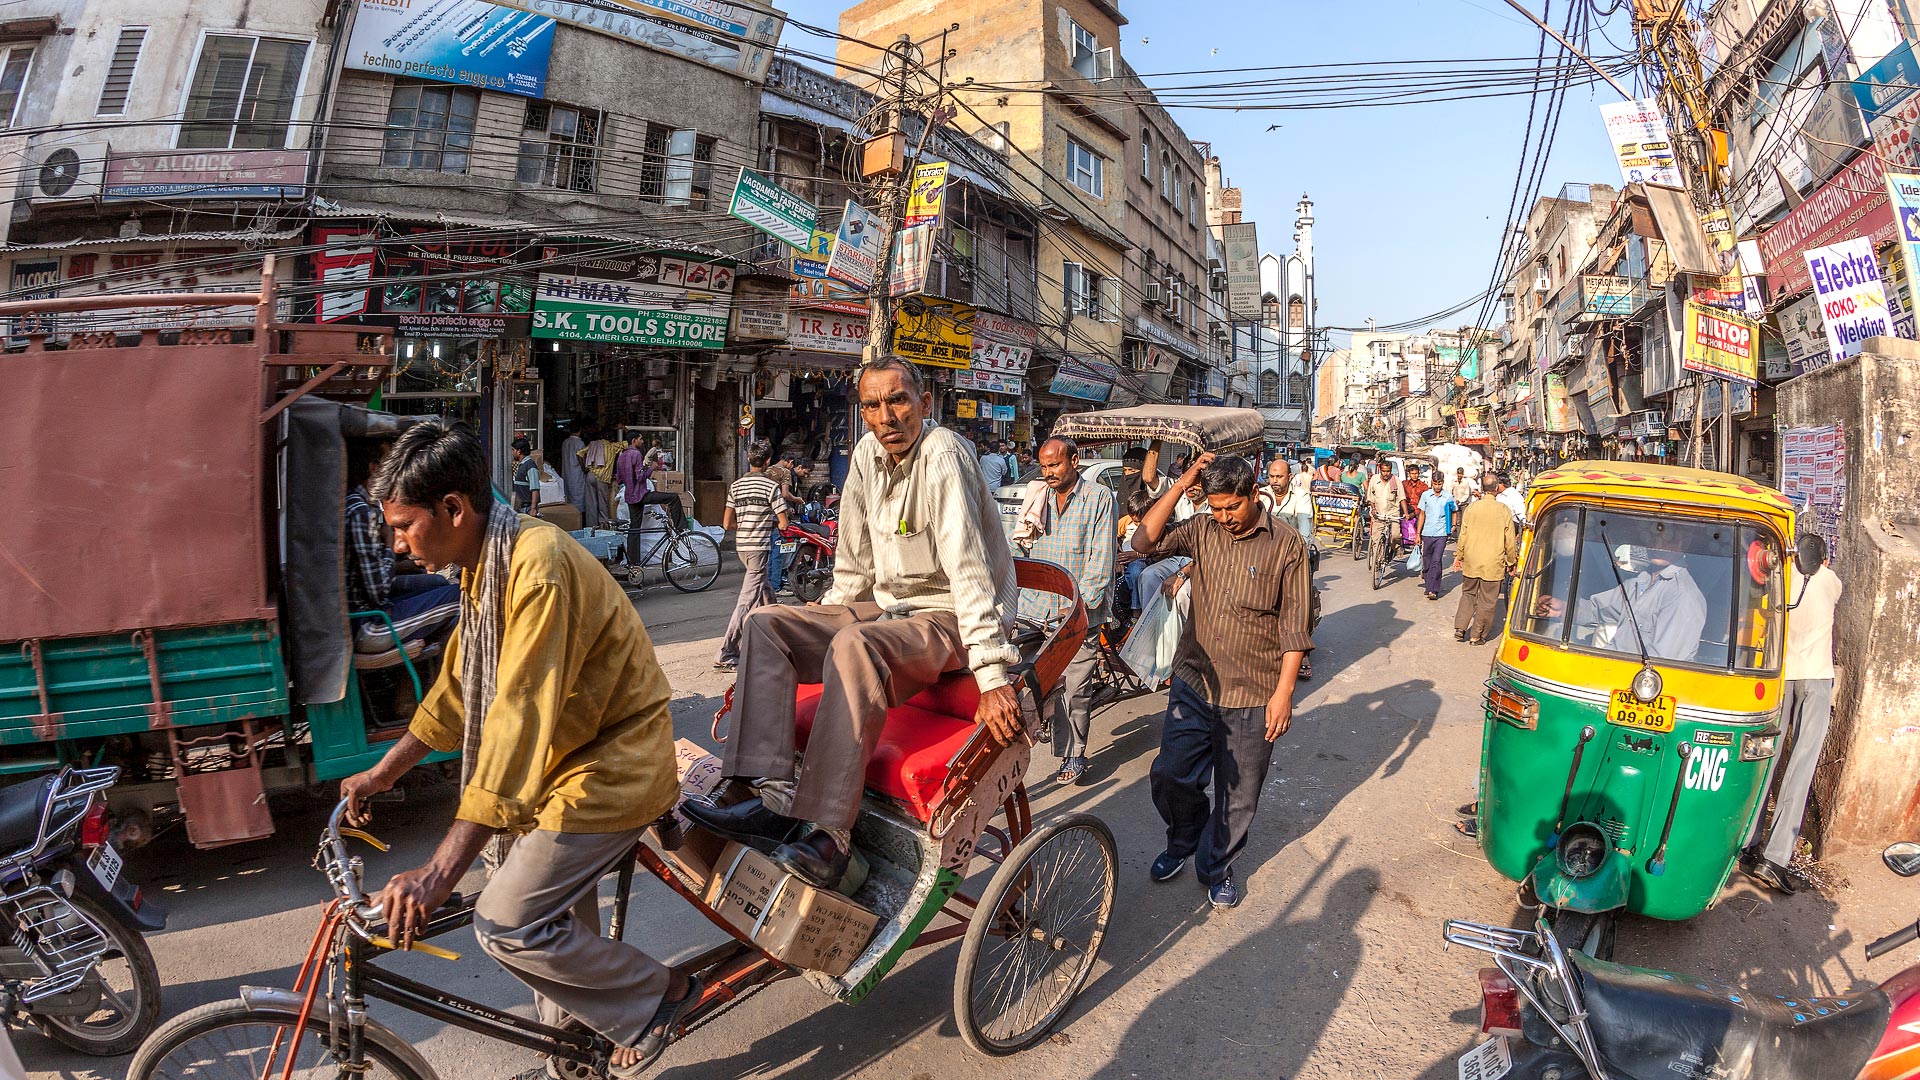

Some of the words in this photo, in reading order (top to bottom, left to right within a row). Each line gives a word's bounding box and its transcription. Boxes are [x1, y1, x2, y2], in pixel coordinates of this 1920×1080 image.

[380, 6, 404, 16] Germany
[668, 2, 698, 19] LIFTING
[700, 13, 731, 30] TACKLES
[363, 52, 402, 70] techno
[404, 59, 455, 79] perfecto
[1627, 113, 1648, 124] SALES
[155, 155, 235, 172] ALCOCK
[916, 168, 944, 179] Unbrako
[140, 185, 168, 193] FLOOR)
[742, 176, 779, 201] JAGDAMBA
[779, 195, 816, 221] FASTENERS
[1761, 217, 1800, 264] GOODLUCK
[1796, 177, 1851, 239] ENGINEERING
[1846, 154, 1886, 203] WORKS
[1702, 219, 1729, 233] rako
[1809, 228, 1834, 249] BEADING
[1840, 206, 1866, 230] PLASTIC
[1846, 228, 1862, 241] PIPE.
[453, 254, 497, 264] PROFESSIONAL
[838, 243, 876, 268] STARLINE
[604, 260, 630, 272] TOOLS
[1810, 251, 1878, 296] Electra
[14, 270, 57, 291] ALCOCK
[399, 315, 430, 325] techno
[431, 315, 468, 327] perfecto
[469, 318, 491, 329] engg.
[493, 318, 506, 327] co.
[637, 310, 649, 318] PH
[533, 309, 577, 330] S.K.
[586, 313, 658, 336] TOOLS
[663, 320, 726, 342] STORE
[800, 317, 828, 336] T.R.
[831, 322, 843, 337] &
[991, 319, 1014, 333] TOOLS
[1017, 325, 1038, 338] STORE
[1697, 314, 1751, 346] HILTOP
[1834, 315, 1887, 346] Welding
[558, 331, 583, 340] 4104,
[585, 333, 620, 342] AJMERI
[622, 335, 648, 344] GATE,
[650, 337, 703, 348] DELHI-110006
[1697, 335, 1723, 351] ANCHOR
[1723, 342, 1749, 358] FASTNER
[898, 341, 927, 355] RUBBER
[931, 346, 949, 358] HOSE
[951, 348, 971, 361] INDIA
[1695, 731, 1710, 743] RE
[1684, 745, 1729, 791] CNG
[747, 864, 767, 881] CHINA
[768, 879, 779, 888] IN
[735, 880, 757, 897] abrasive
[726, 890, 745, 907] Cut
[815, 905, 828, 916] CM
[811, 914, 826, 926] KGS
[805, 923, 821, 935] KGS
[800, 932, 816, 944] PCS
